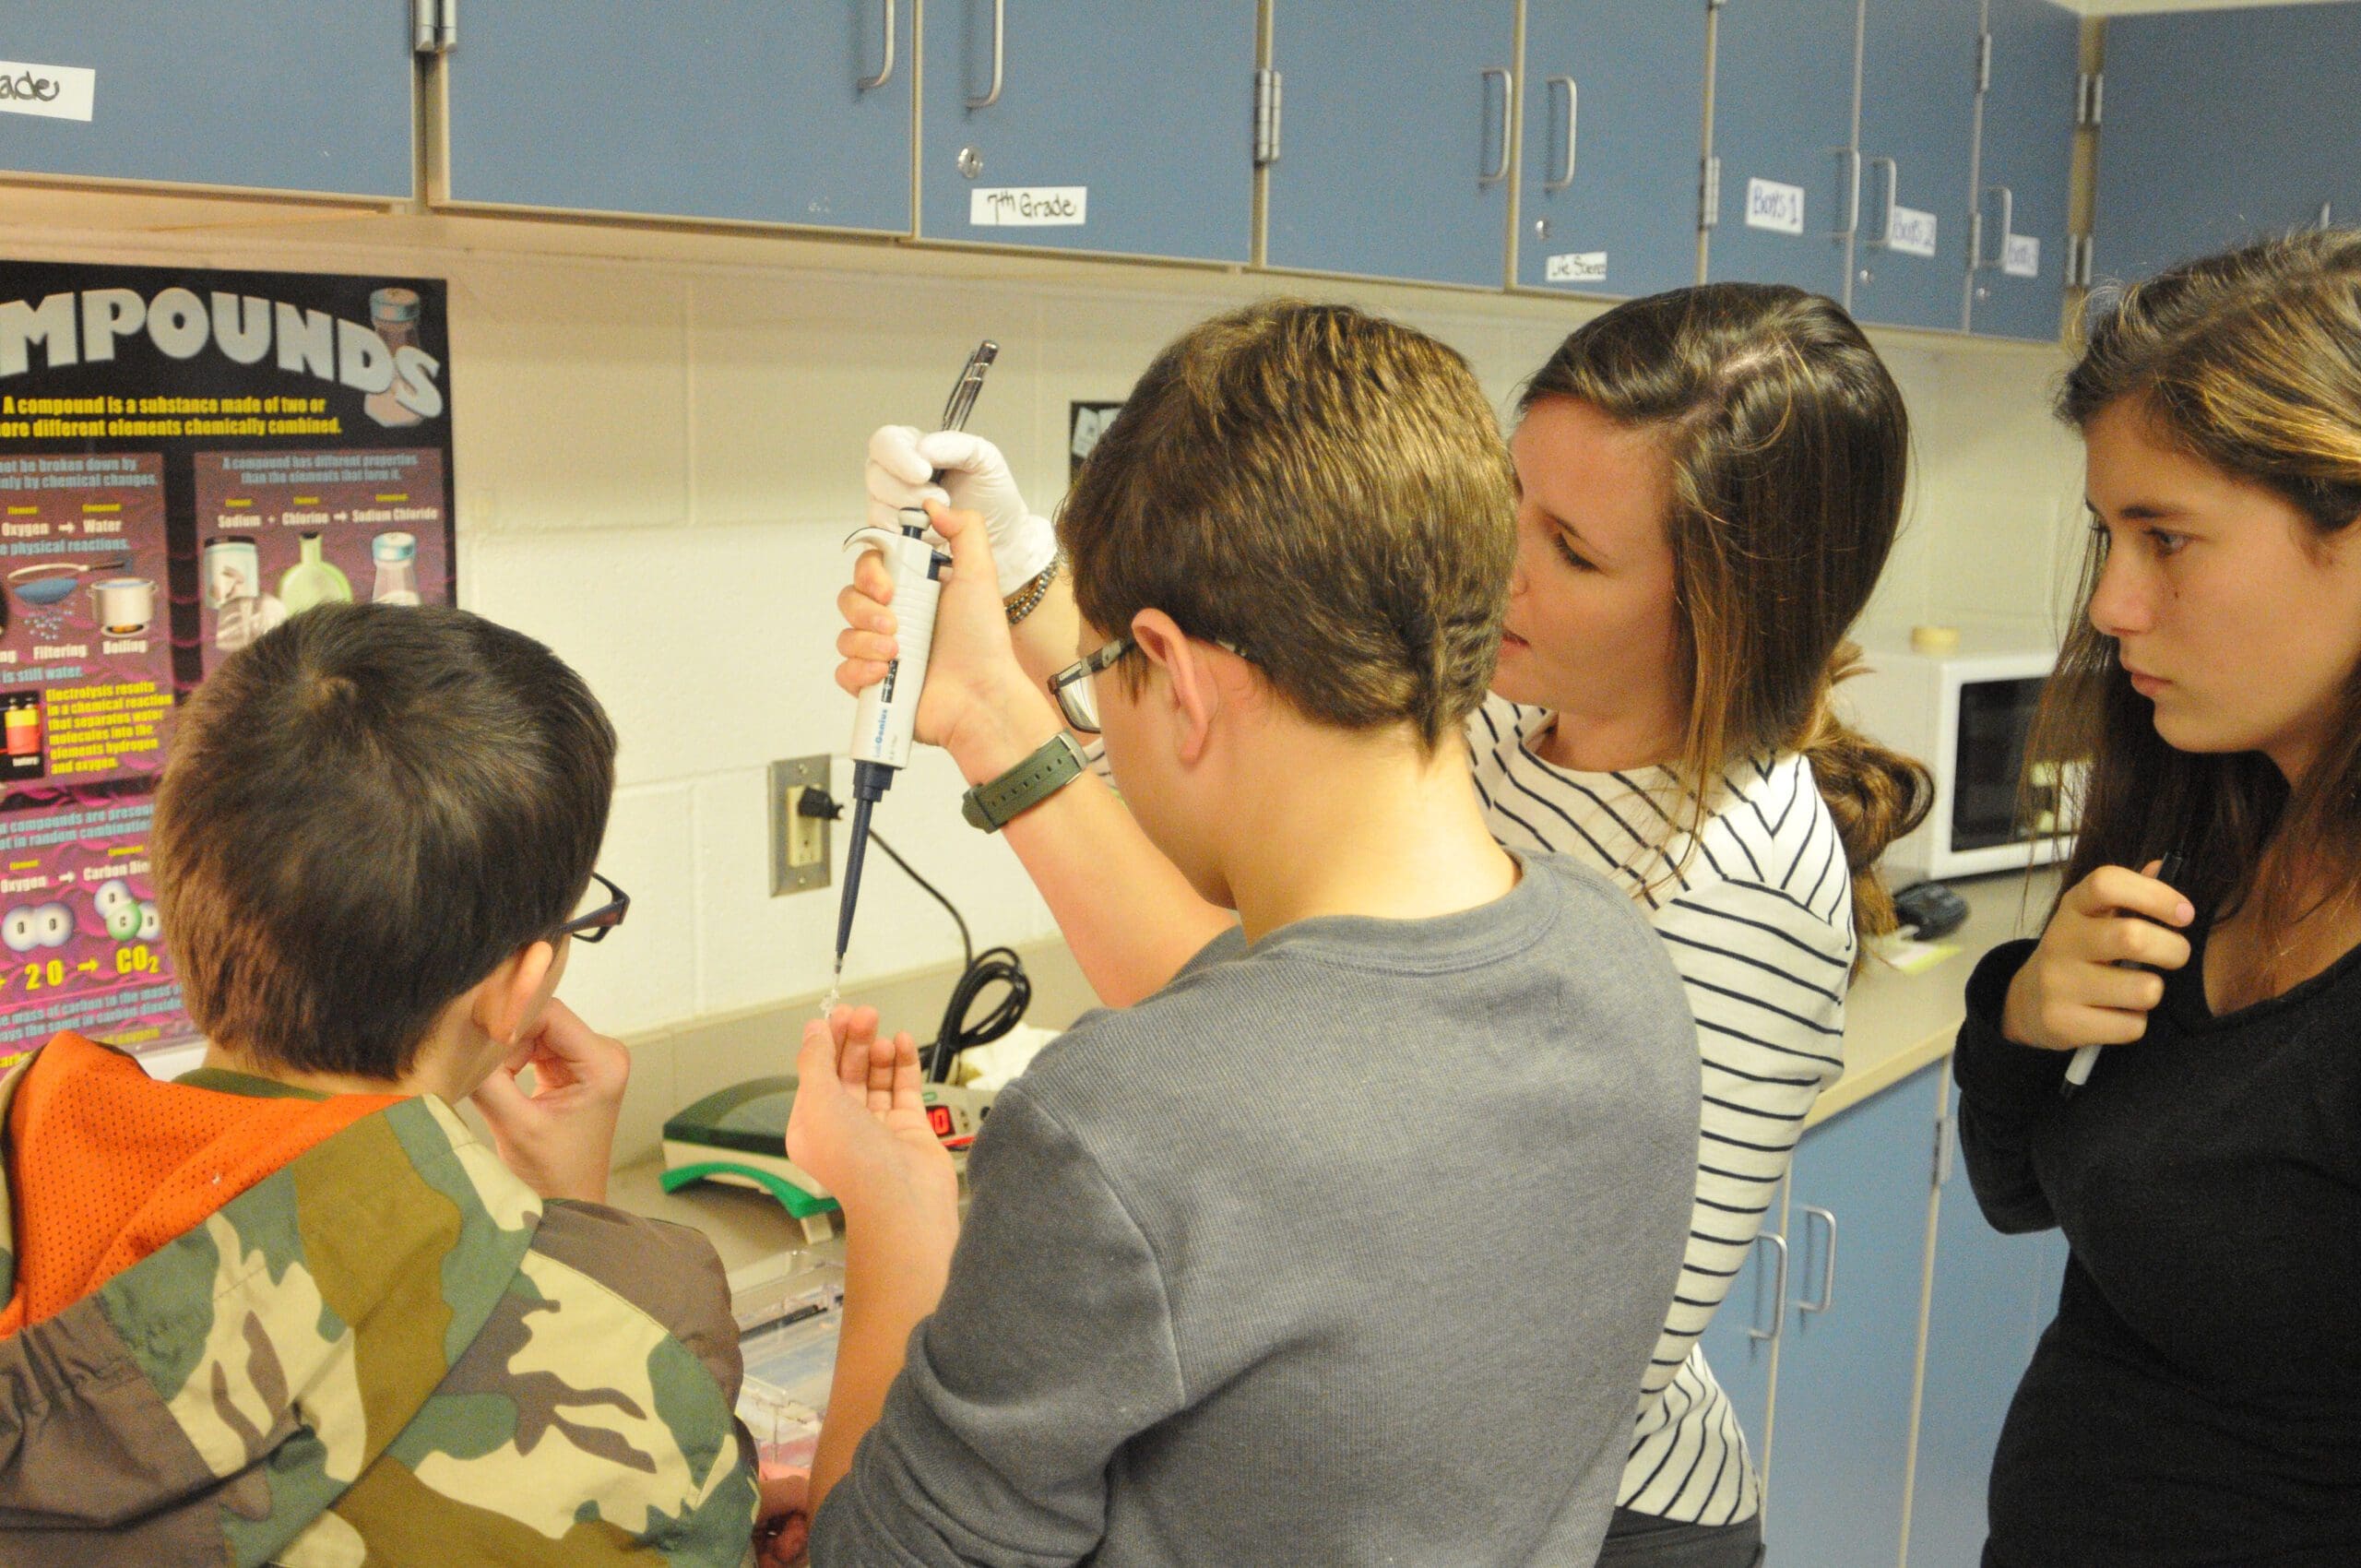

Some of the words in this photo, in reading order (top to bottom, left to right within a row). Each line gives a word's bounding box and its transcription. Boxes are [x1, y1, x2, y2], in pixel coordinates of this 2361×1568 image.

[1019, 192, 1077, 218] Grade
[3, 396, 16, 414] A
[17, 397, 104, 415] compound
[107, 396, 124, 414] is
[125, 398, 136, 414] a
[138, 396, 219, 414] substance
[220, 397, 261, 413] made
[264, 397, 279, 413] of
[281, 397, 307, 413] two
[309, 398, 326, 413] or
[32, 419, 106, 437] different
[108, 418, 183, 436] elements
[184, 418, 266, 436] chemically
[2, 522, 50, 537] Oxygen
[83, 519, 122, 533] Water
[218, 514, 262, 529] Sodium
[281, 511, 330, 526] Chlorine
[33, 645, 88, 660] Filtering
[103, 640, 148, 655] Boiling
[47, 683, 113, 702] Electrolysis
[115, 681, 155, 695] results
[71, 698, 124, 714] chemical
[125, 694, 173, 708] reaction
[73, 712, 130, 729] separates
[132, 709, 163, 723] water
[49, 728, 109, 745] molecules
[50, 742, 103, 760] elements
[105, 738, 159, 754] hydrogen
[52, 760, 73, 775] and
[10, 814, 82, 833] compounds
[1, 875, 47, 893] Oxygen
[84, 863, 128, 881] Carbon
